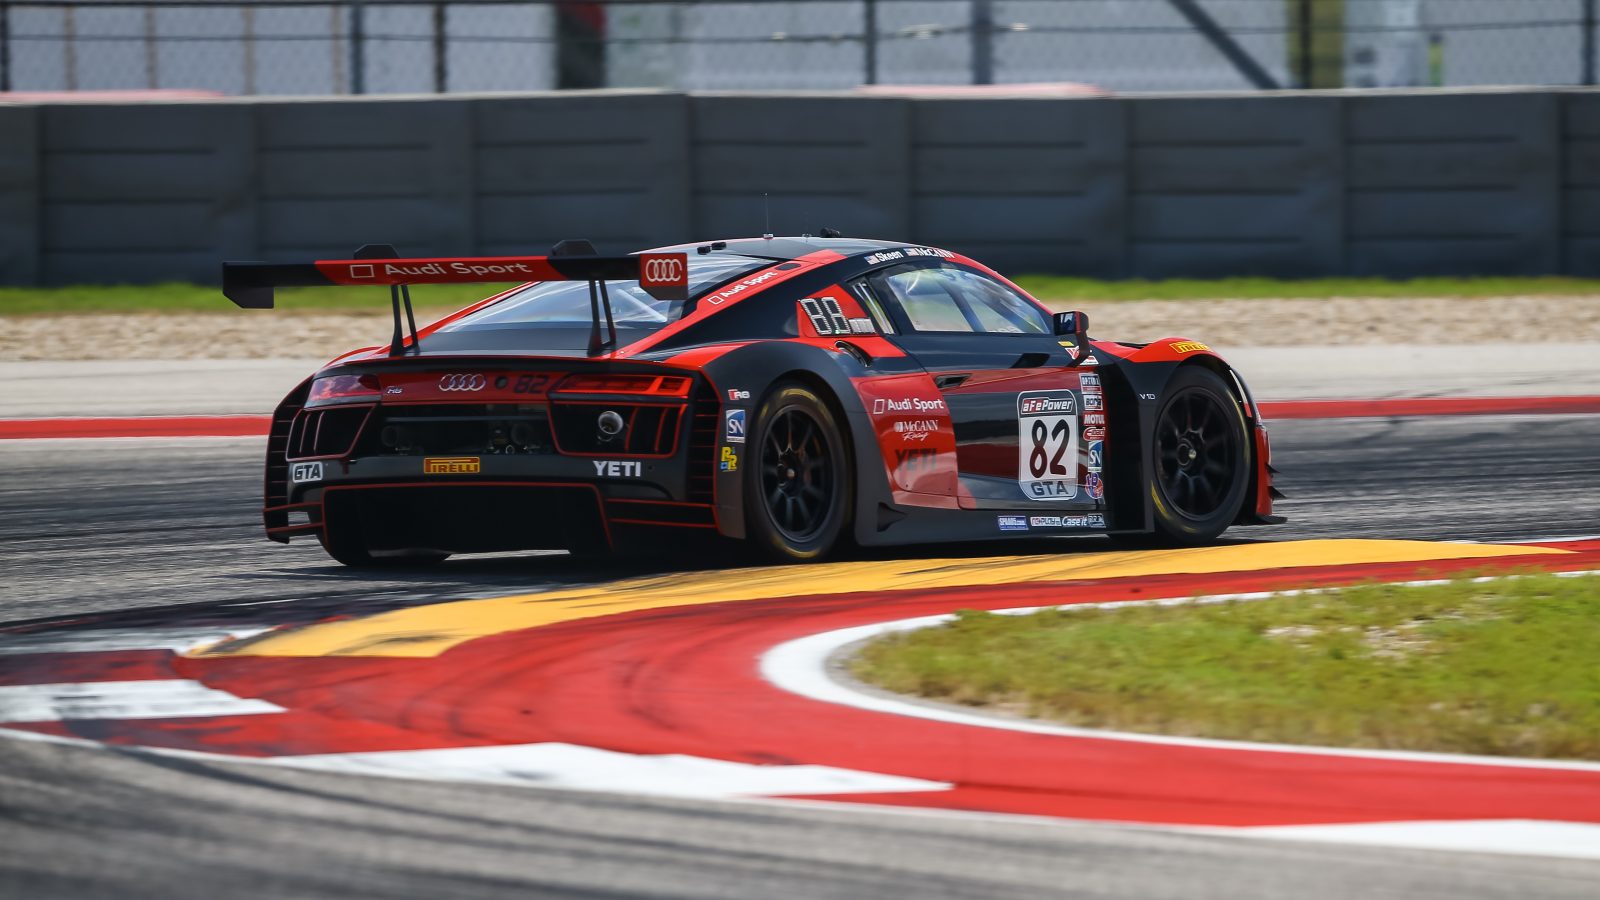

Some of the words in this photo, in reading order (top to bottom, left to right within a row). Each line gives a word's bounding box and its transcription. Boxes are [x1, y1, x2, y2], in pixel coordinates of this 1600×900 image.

[875, 251, 904, 262] Skeen
[385, 263, 447, 276] Audi
[450, 262, 533, 276] Sport
[720, 284, 748, 297] Audi
[743, 271, 778, 286] Sport
[887, 398, 912, 411] Audi
[913, 397, 944, 412] Sport
[1022, 399, 1072, 412] aFePower
[728, 418, 744, 434] SN
[903, 420, 939, 432] McCANN
[1084, 413, 1105, 425] MOTUL
[1029, 418, 1070, 479] 82
[425, 458, 478, 473] PIRELLI
[895, 448, 938, 472] YETI
[293, 463, 322, 481] GTA
[593, 460, 641, 477] YETI
[1031, 481, 1069, 496] GTA
